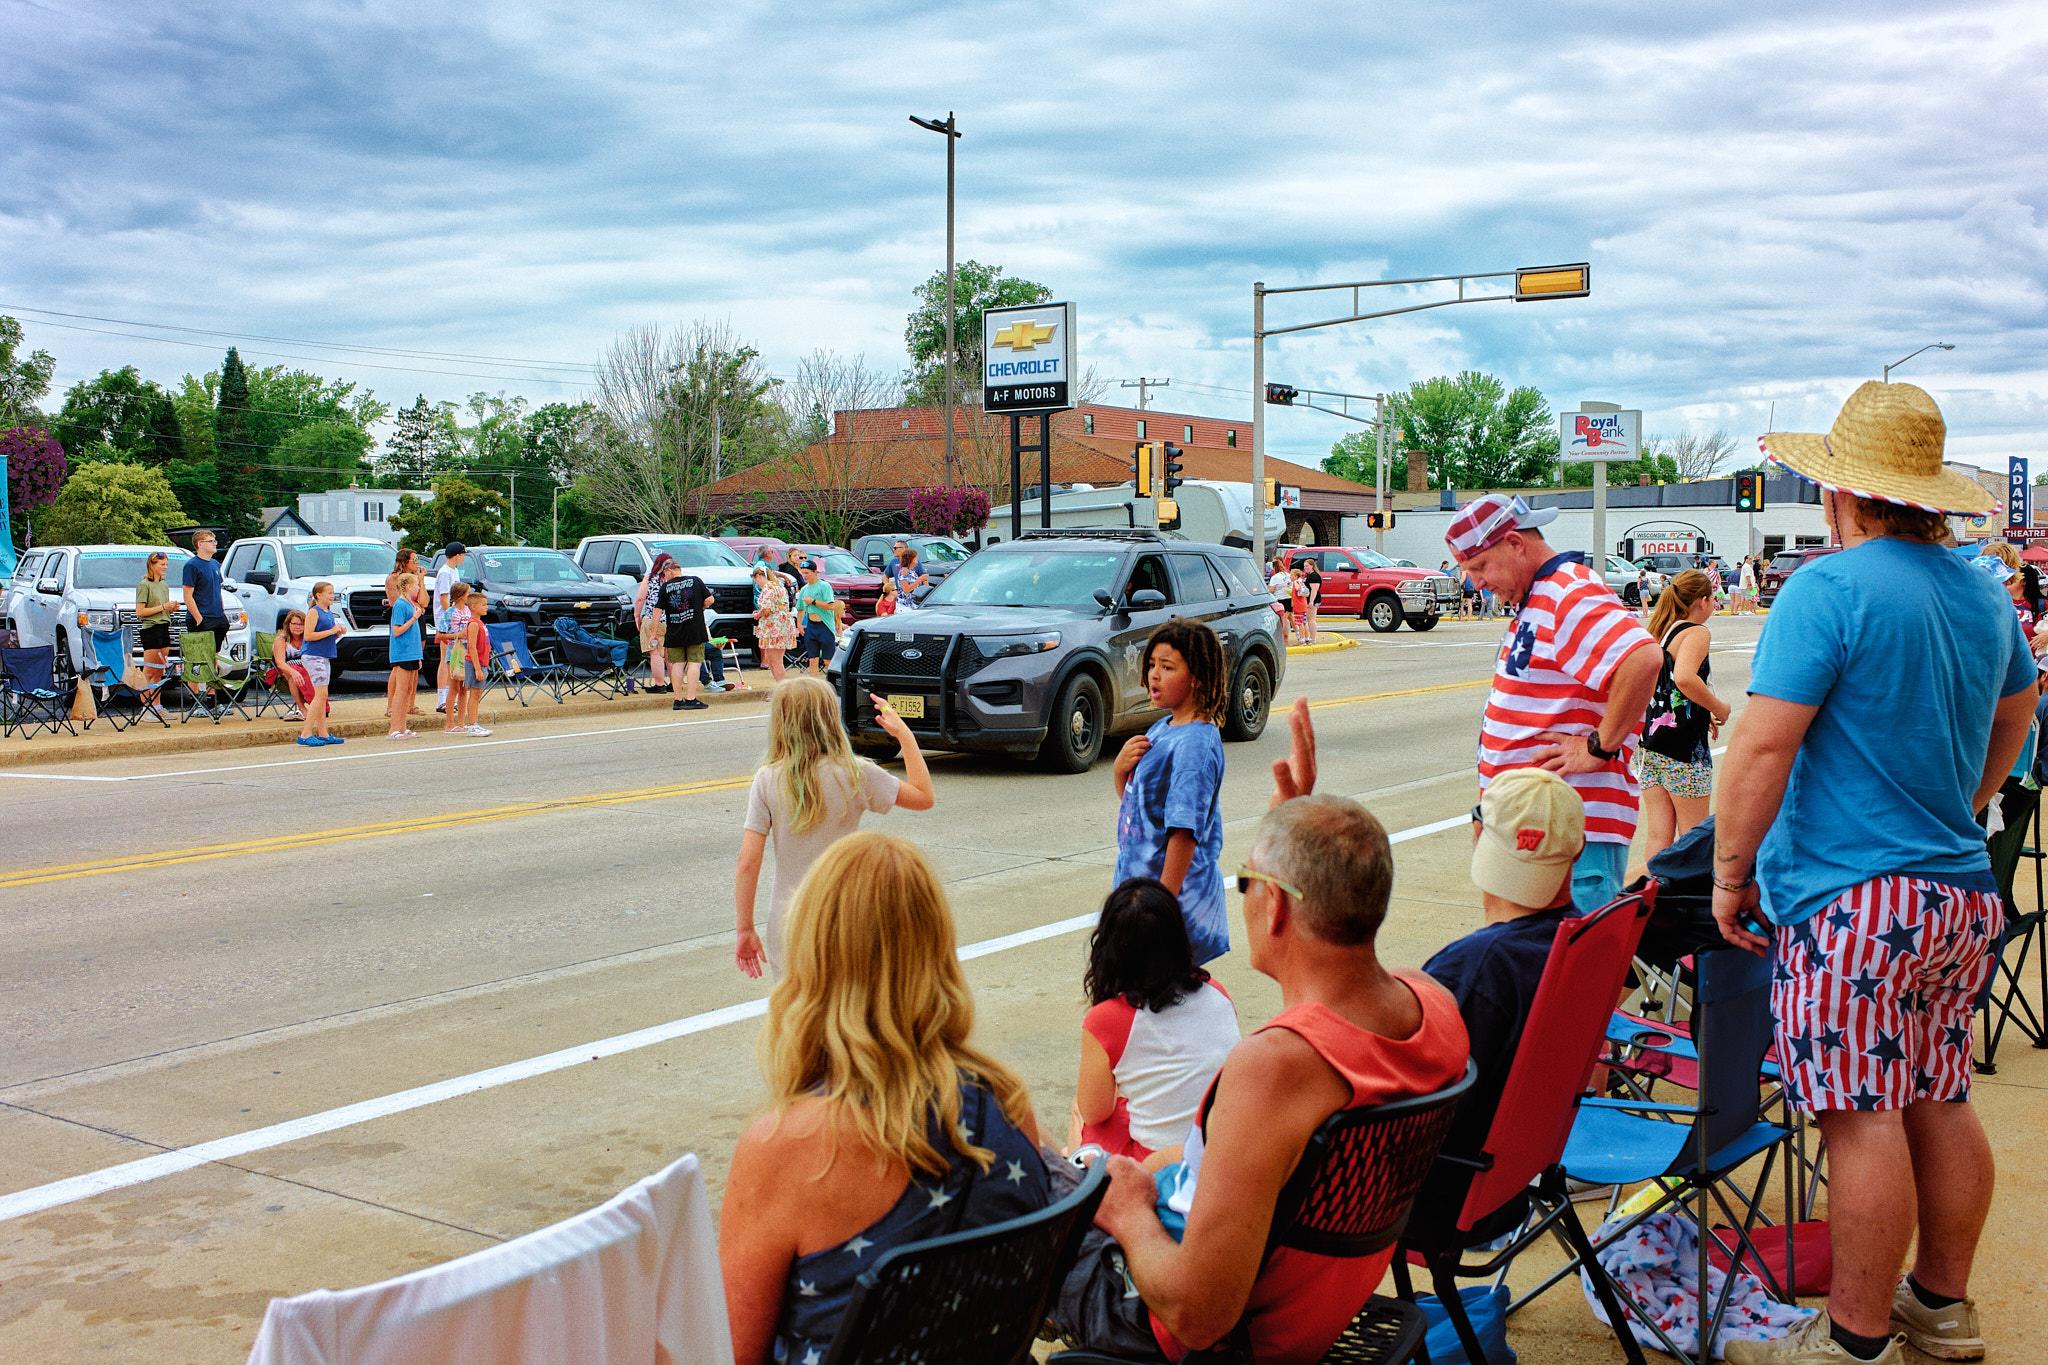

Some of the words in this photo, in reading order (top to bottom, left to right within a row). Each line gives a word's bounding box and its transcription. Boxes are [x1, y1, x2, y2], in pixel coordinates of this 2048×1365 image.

[989, 359, 1059, 377] CHEVROLET
[993, 390, 1009, 402] A-F
[1014, 386, 1056, 400] MOTORS
[1575, 414, 1618, 435] Royal
[1587, 426, 1625, 447] Bank
[2012, 462, 2024, 523] ADAMS
[2005, 529, 2046, 538] THEATRE
[900, 701, 921, 713] F1552
[1515, 828, 1546, 851] W
